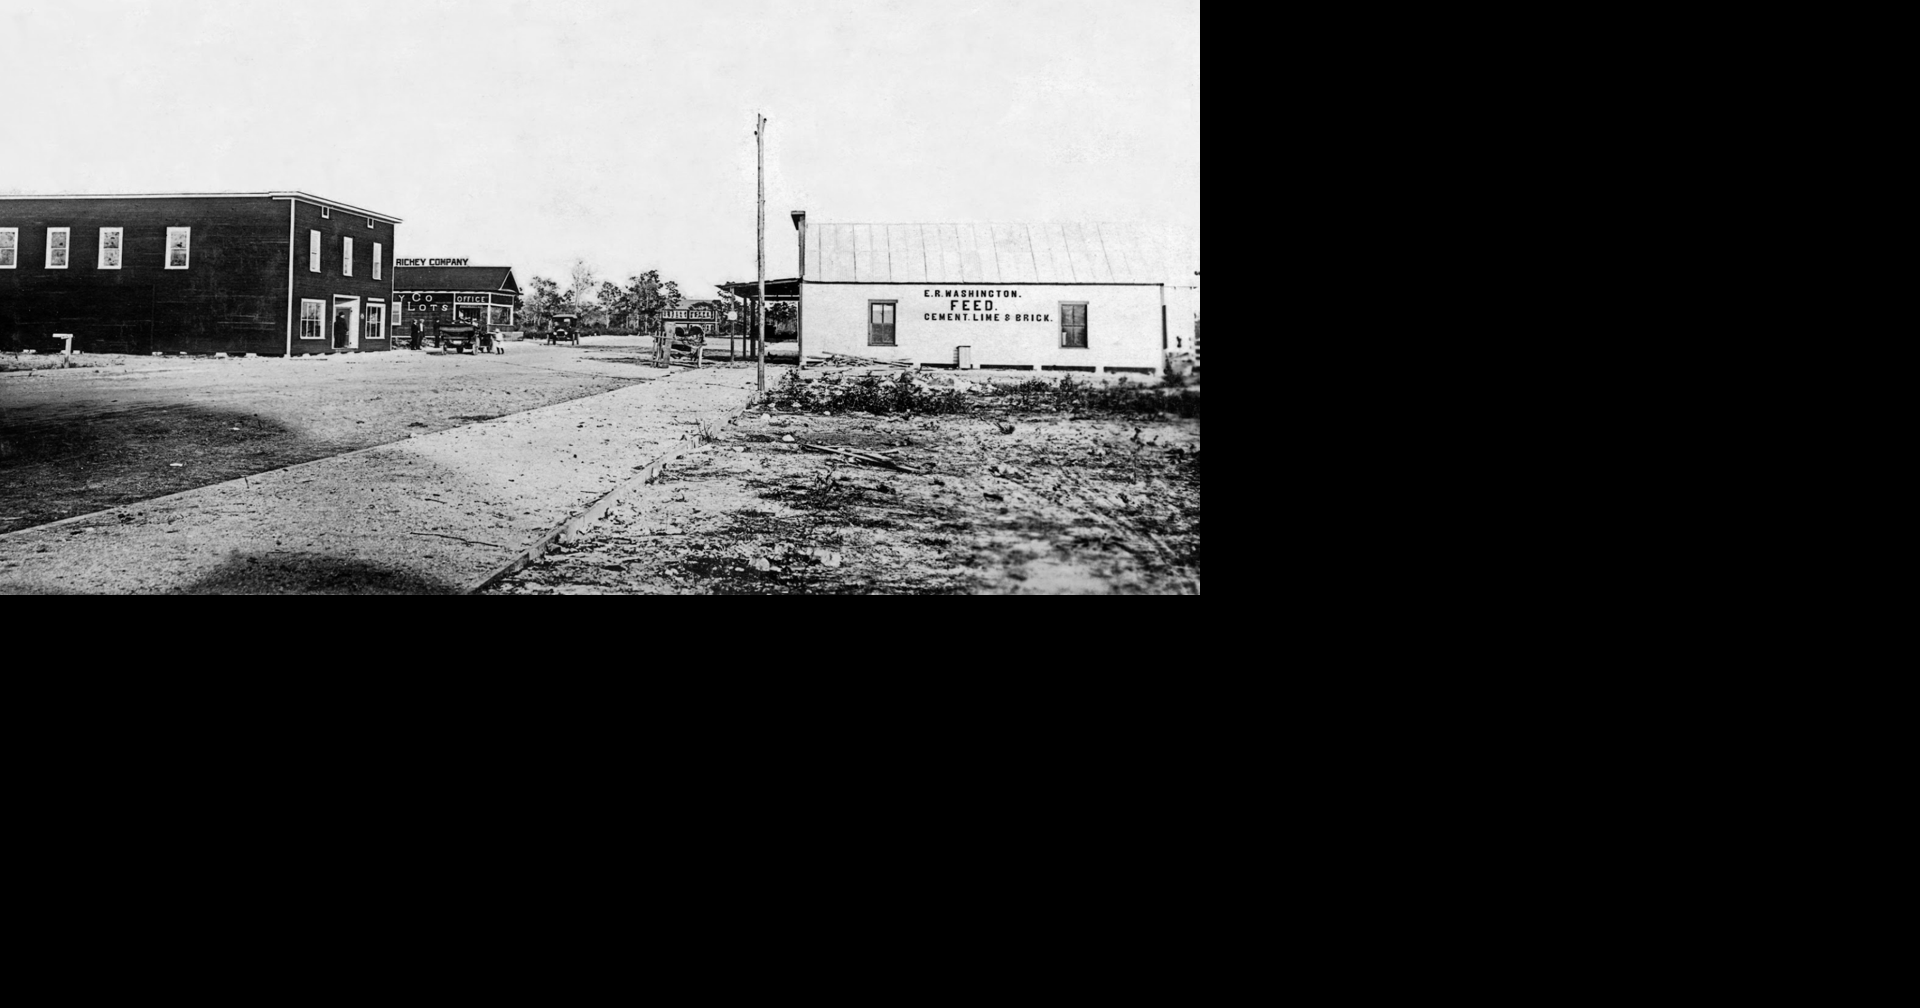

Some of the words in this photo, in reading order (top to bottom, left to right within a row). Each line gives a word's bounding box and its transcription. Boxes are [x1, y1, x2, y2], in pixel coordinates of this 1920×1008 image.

[396, 258, 426, 266] RICHEY
[429, 258, 468, 266] COMPANY
[456, 295, 486, 303] OFFICE
[407, 301, 449, 312] LOTS
[950, 300, 998, 311] FEED.
[973, 313, 1000, 322] LIME
[1015, 314, 1053, 322] BRICK.
